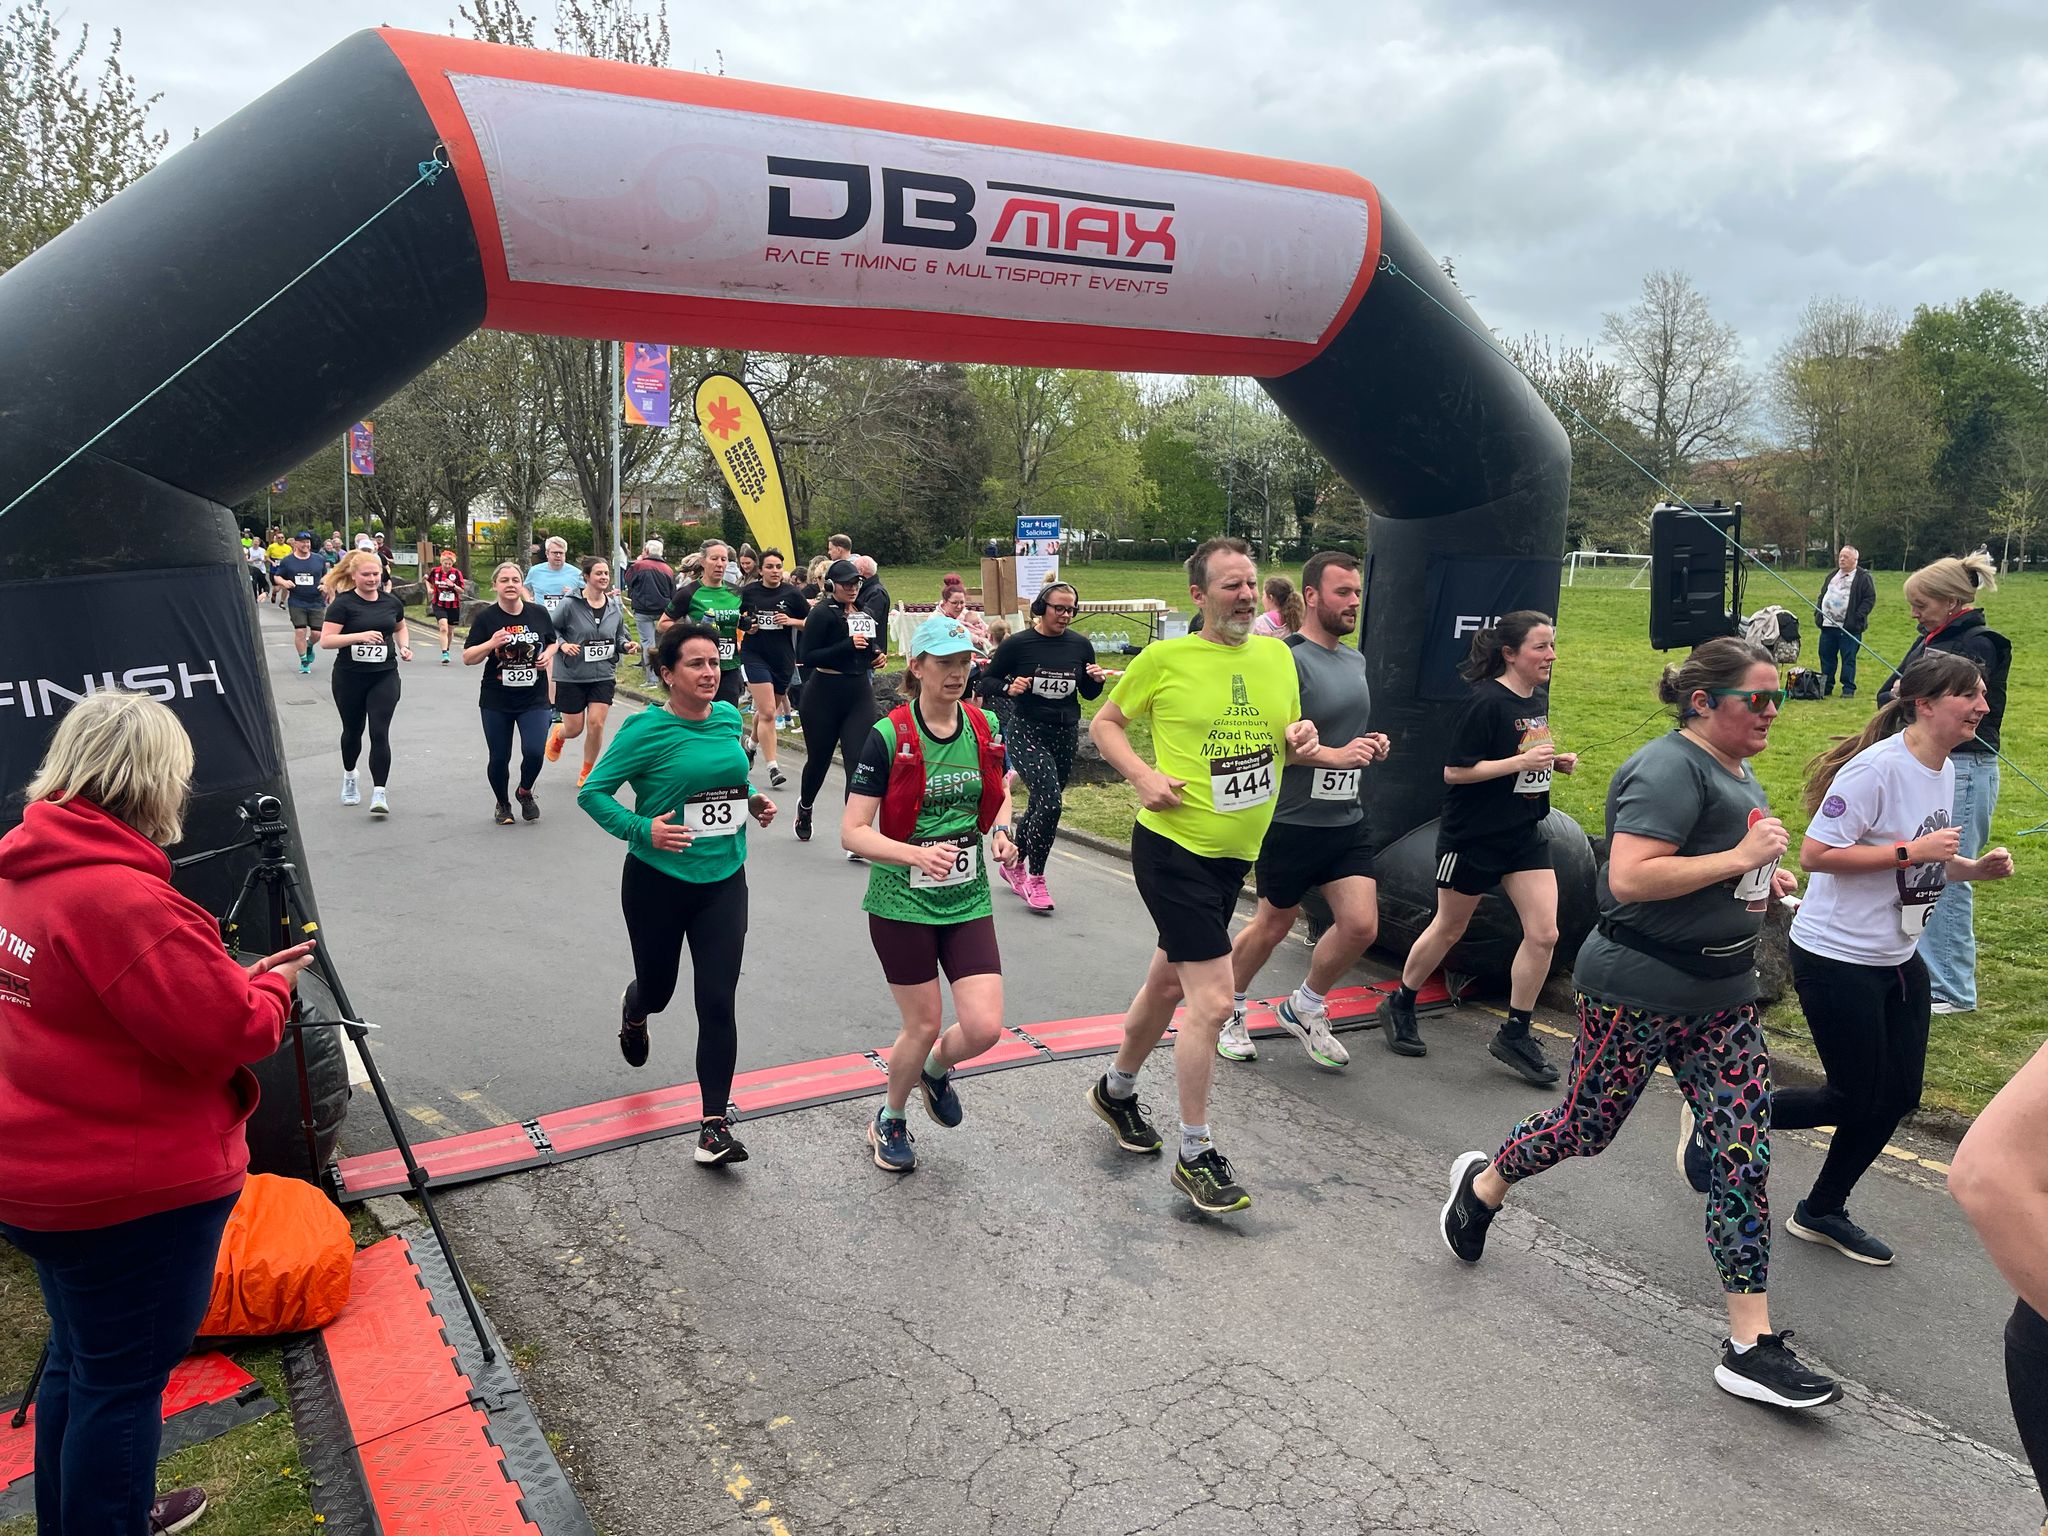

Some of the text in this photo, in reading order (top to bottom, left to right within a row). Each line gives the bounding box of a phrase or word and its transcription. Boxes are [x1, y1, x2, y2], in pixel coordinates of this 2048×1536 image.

[767, 155, 977, 251] DB
[989, 197, 1176, 261] MAX
[765, 247, 1169, 295] RACE TIMING & MULTISPORT EVENTS
[744, 436, 767, 482] BRISTOL
[725, 449, 750, 496] CHARITY
[730, 445, 760, 504] HOSPITALS
[737, 441, 765, 495] & WESTON
[1040, 521, 1057, 529] Legal
[758, 616, 776, 626] 56
[852, 620, 871, 632] 229
[504, 632, 539, 645] oyage
[357, 646, 383, 657] 572
[589, 646, 610, 657] 567
[507, 670, 533, 682] 329
[1039, 679, 1069, 694] 443
[1223, 706, 1260, 716] 33RD
[1213, 718, 1269, 727] Glastonbury
[1208, 729, 1273, 740] Road Runs
[1200, 743, 1230, 758] May
[1233, 743, 1253, 756] 4th
[926, 770, 981, 788] MERSON
[1224, 767, 1271, 799] 444
[1322, 771, 1355, 791] 571
[924, 783, 964, 798] REEN
[701, 802, 732, 826] 83
[7, 932, 36, 965] THE
[0, 994, 32, 1008] EVENTS
